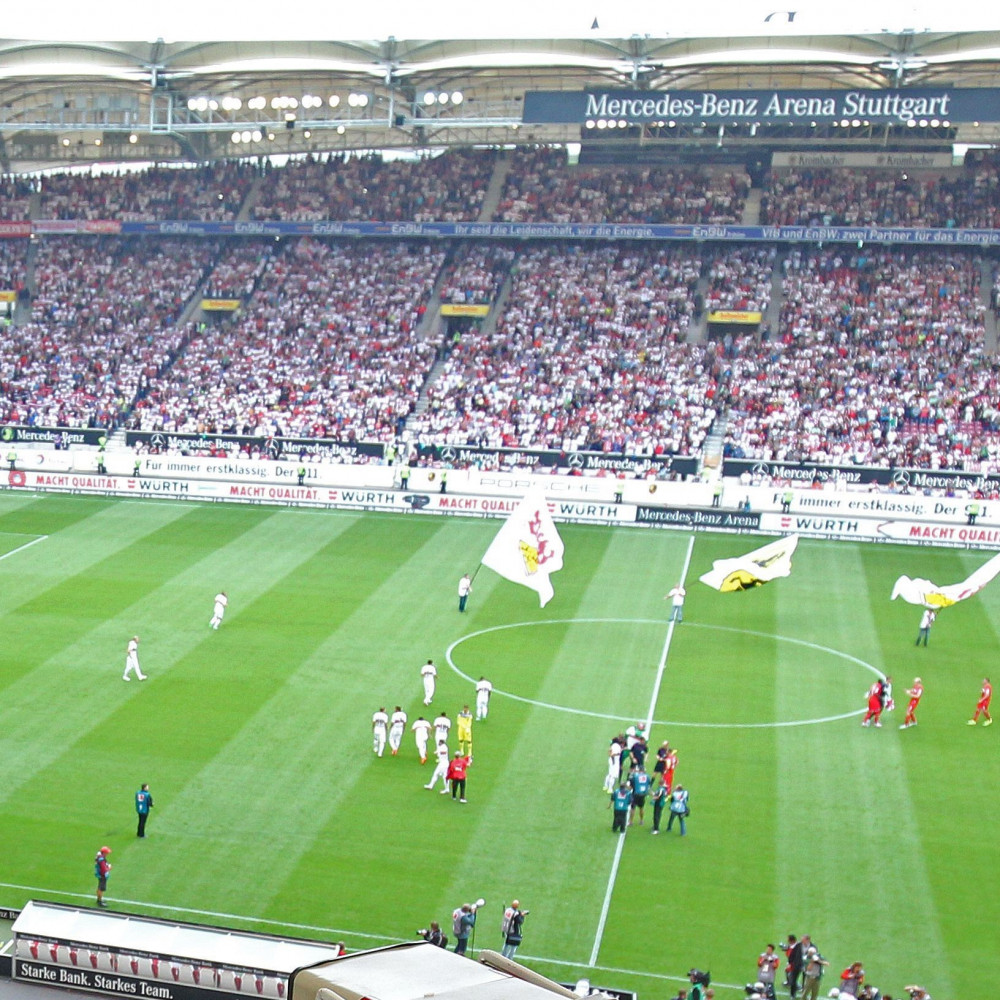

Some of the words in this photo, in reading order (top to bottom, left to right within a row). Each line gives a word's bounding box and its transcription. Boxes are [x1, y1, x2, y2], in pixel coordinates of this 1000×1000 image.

[585, 93, 758, 117] Mercedes-Benz
[764, 92, 836, 116] Arena
[842, 93, 951, 120] Stuttgart
[870, 229, 912, 241] Partner
[934, 231, 955, 242] das
[167, 462, 201, 472] immer
[206, 464, 270, 478] erstklassig.
[275, 467, 293, 477] Der
[36, 475, 69, 488] MACHT
[139, 480, 189, 493] WÜRTH
[230, 485, 266, 498] MACHT
[341, 490, 395, 504] WÜRTH
[439, 498, 478, 511] MACHT
[560, 503, 618, 517] WÜRTH
[799, 494, 842, 508] immer
[849, 498, 927, 515] erstklassig.
[934, 501, 958, 515] Der
[964, 504, 992, 518] 91.
[639, 508, 722, 525] Mercedes-Benz
[725, 513, 760, 528] Arena
[796, 517, 859, 532] WÜRTH
[909, 525, 957, 540] MACHT
[21, 963, 57, 983] Starke
[59, 969, 92, 988] Bank.
[94, 974, 137, 995] Starkes
[139, 982, 174, 1000] Team.
